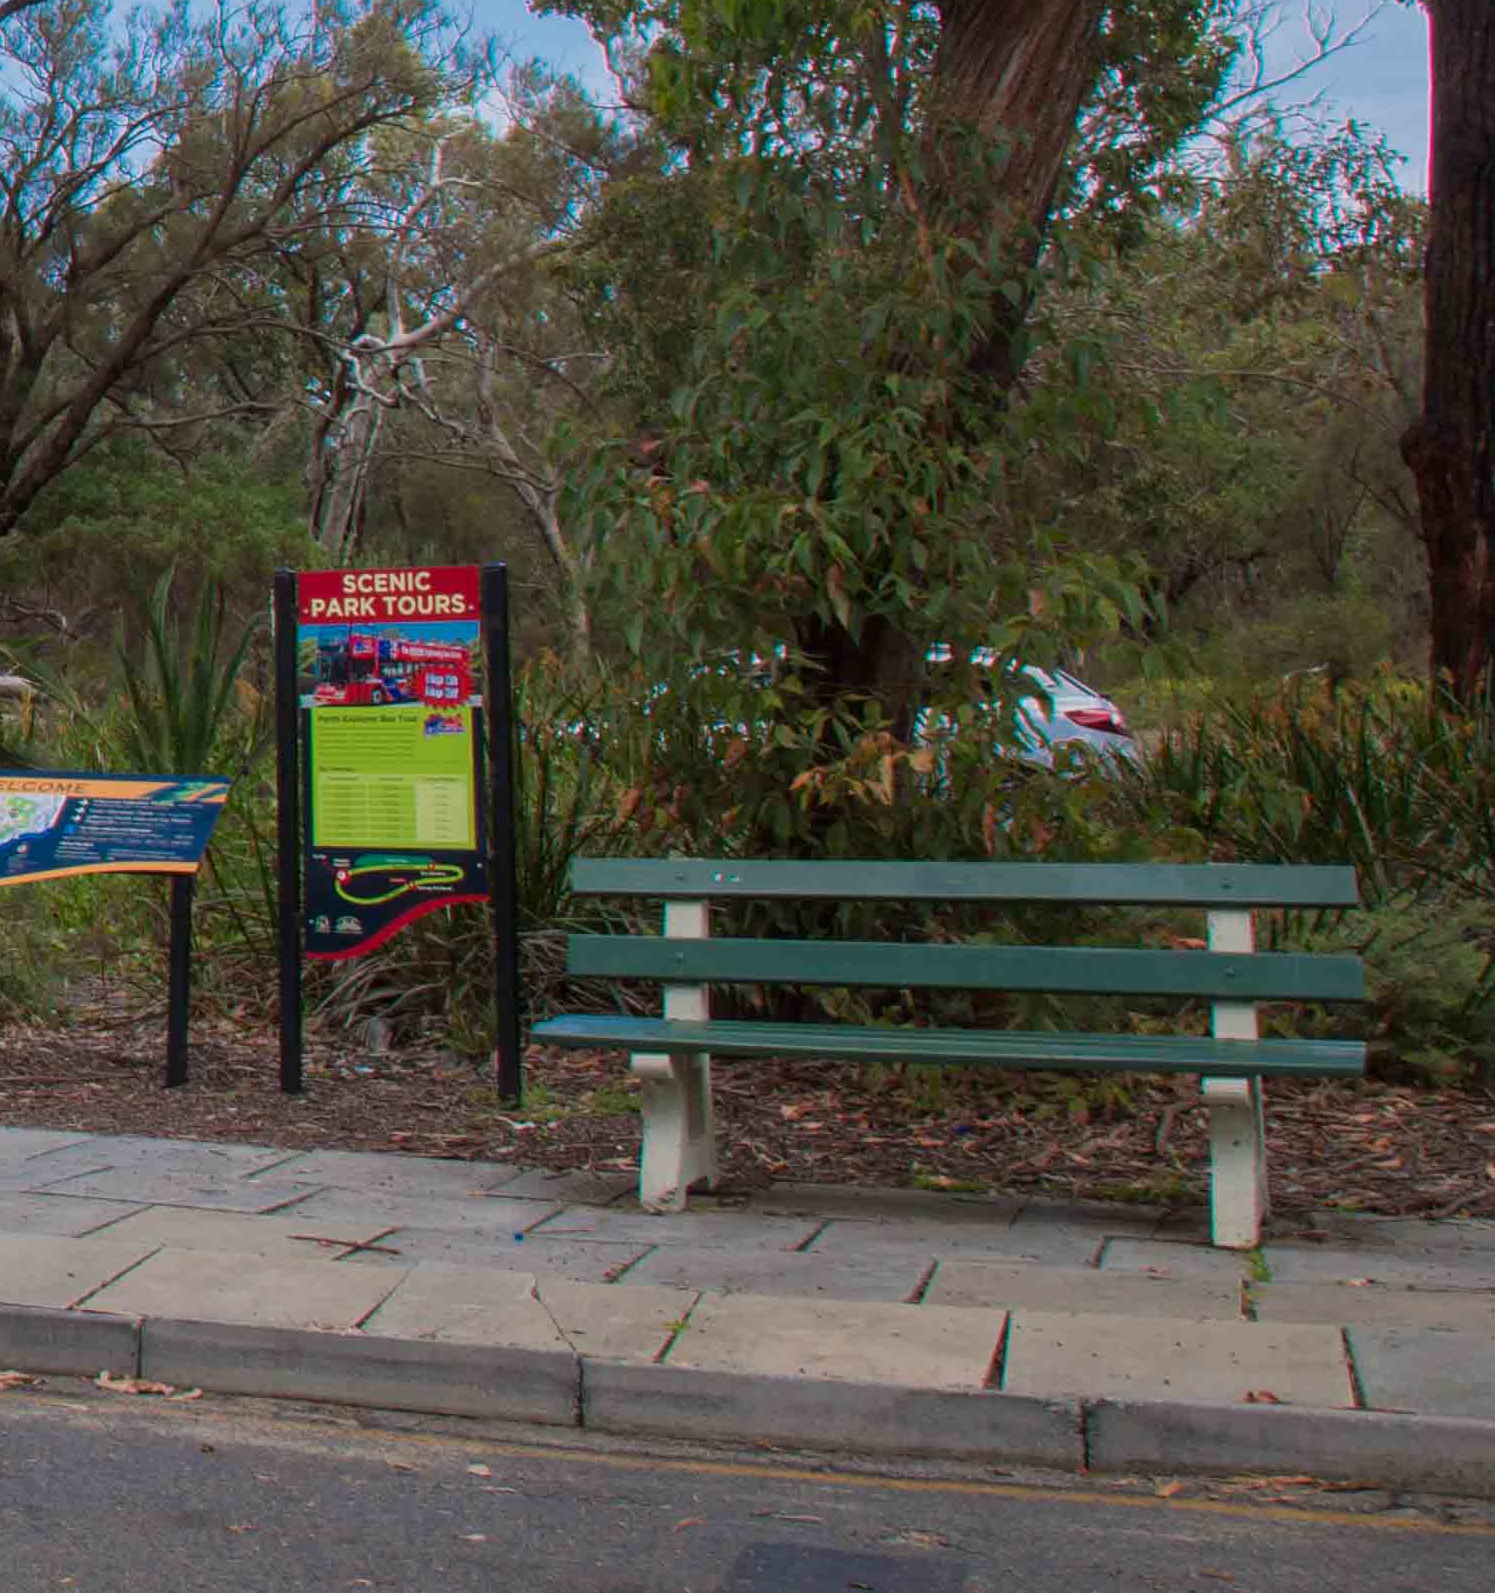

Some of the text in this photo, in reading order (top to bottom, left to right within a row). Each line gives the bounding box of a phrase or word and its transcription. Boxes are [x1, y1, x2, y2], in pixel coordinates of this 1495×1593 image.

[342, 571, 431, 594] SCENIC
[311, 593, 466, 618] PARK TOURS
